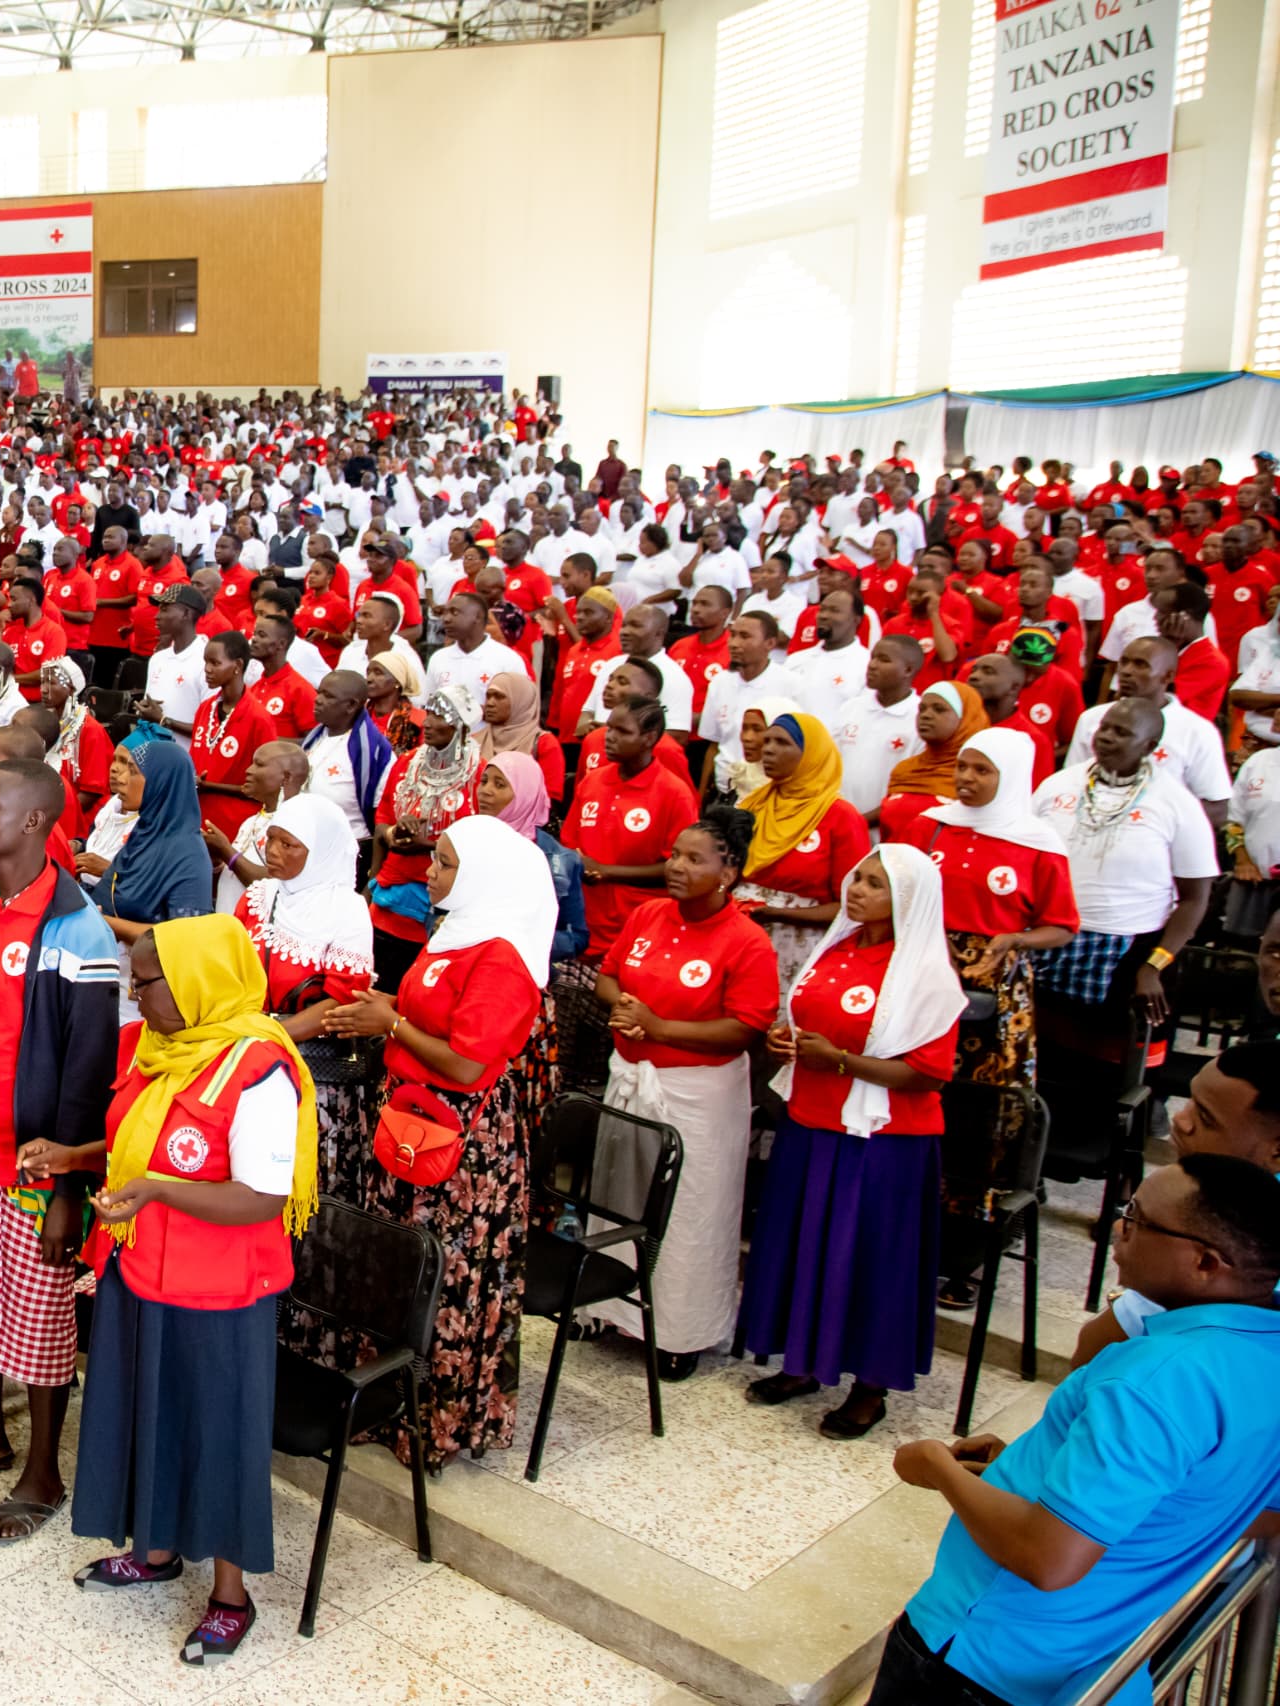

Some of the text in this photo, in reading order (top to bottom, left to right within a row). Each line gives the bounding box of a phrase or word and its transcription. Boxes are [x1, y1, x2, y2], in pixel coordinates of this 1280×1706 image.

[1001, 2, 1087, 53] MIAKA
[1008, 24, 1155, 94] TANZANIA
[1002, 70, 1155, 138] RED CROSS
[1016, 122, 1138, 177] SOCIETY
[989, 241, 1010, 257] the
[1012, 239, 1031, 256] joy
[1042, 231, 1070, 249] give
[1073, 229, 1082, 241] is
[1086, 226, 1096, 239] a
[1098, 212, 1153, 236] reward
[1025, 215, 1054, 236] give
[1057, 208, 1085, 224] with
[13, 303, 33, 312] with
[53, 277, 87, 293] 2024
[581, 801, 599, 818] 62
